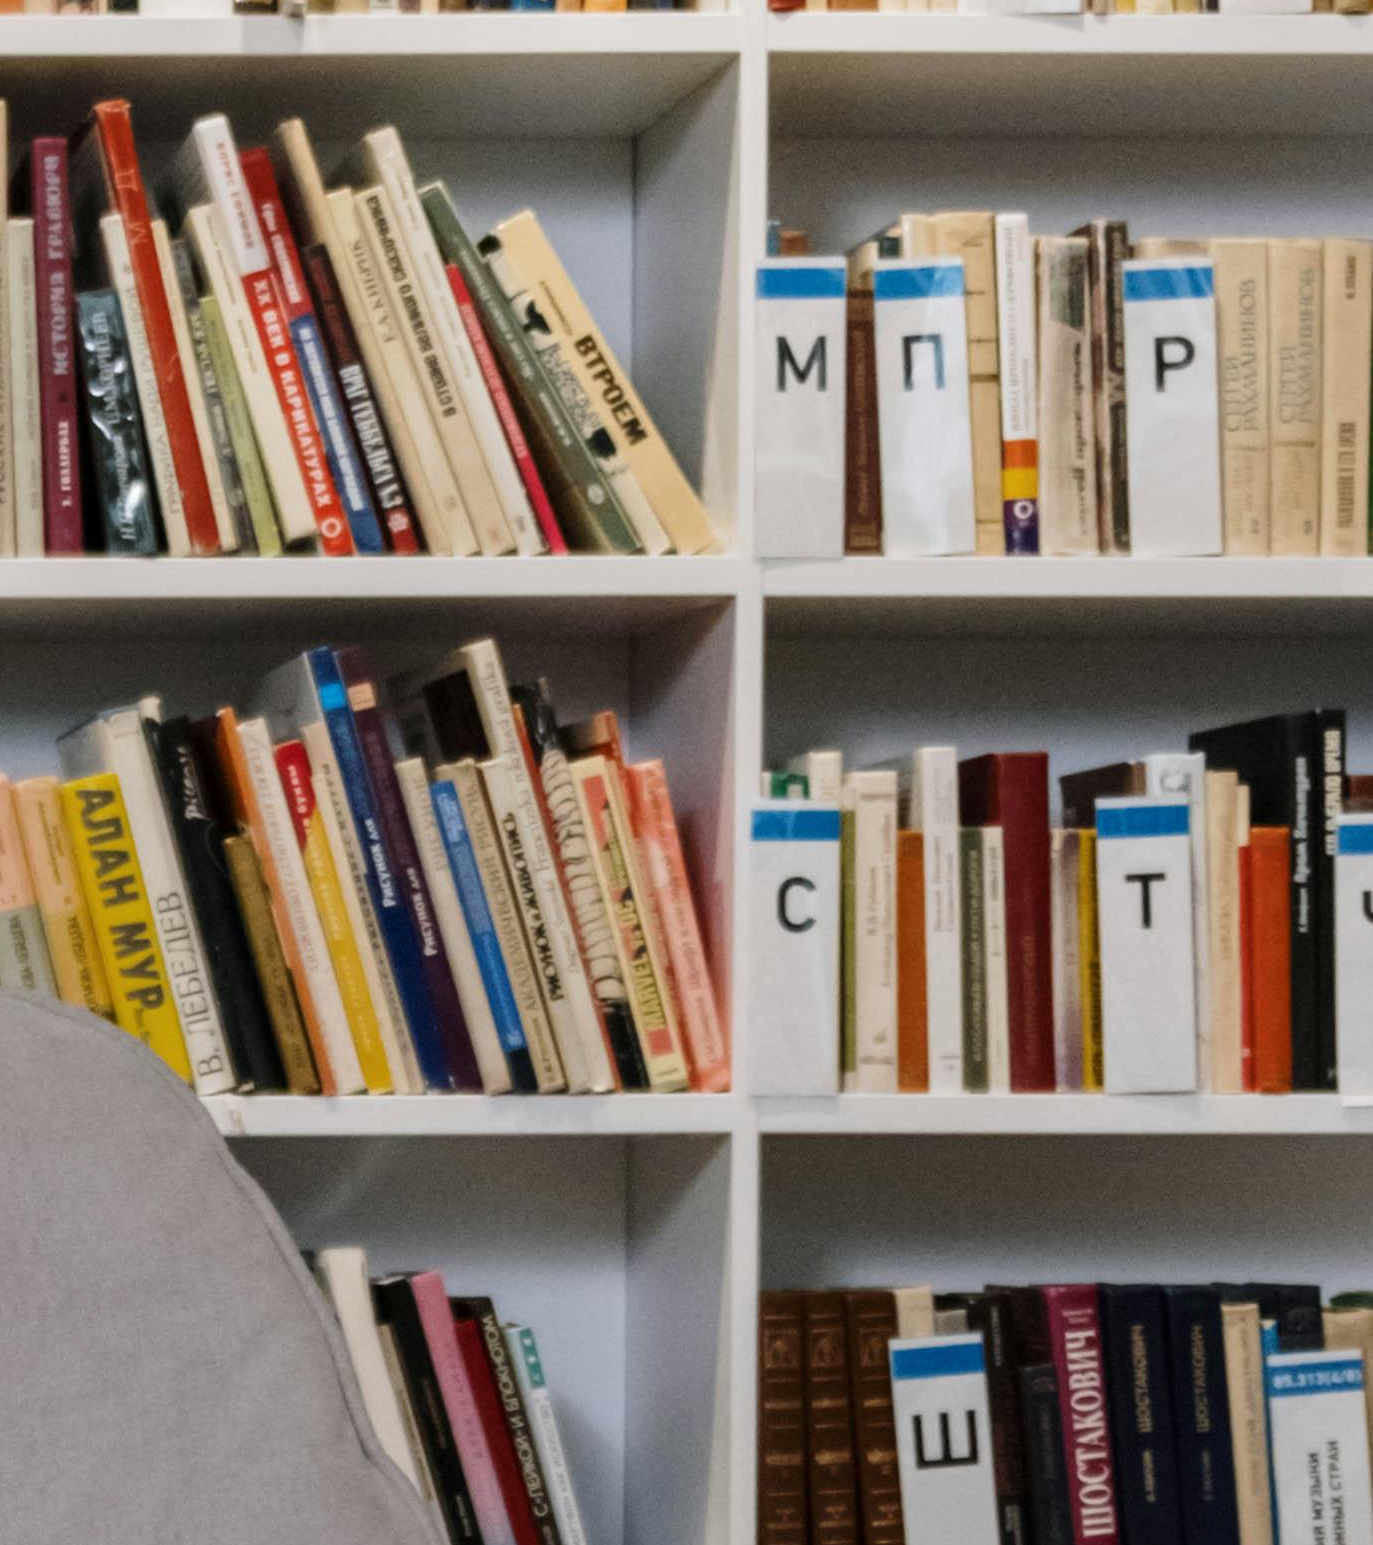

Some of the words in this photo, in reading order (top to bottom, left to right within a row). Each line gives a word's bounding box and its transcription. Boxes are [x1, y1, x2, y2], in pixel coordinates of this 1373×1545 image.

[46, 271, 70, 376] ИСТОРИЯ
[261, 309, 281, 348] ВЕК
[275, 352, 287, 365] В
[776, 334, 829, 392] М
[903, 333, 945, 391] П
[1155, 335, 1196, 393] Р
[571, 333, 649, 447] ВТРОЕМ
[280, 371, 328, 508] КАРИКАТУРАХ
[74, 787, 126, 903] АЛАН
[109, 920, 166, 1010] МУР
[777, 876, 817, 932] С
[1125, 871, 1166, 929] Т
[155, 891, 217, 1037] ЛЕБЕДЕВ
[194, 1046, 225, 1078] В.
[913, 1408, 979, 1469] Ш
[1067, 1327, 1114, 1537] ШОСТАКОВИЧ
[1307, 1452, 1320, 1527] МУЗЫКИ
[1326, 1440, 1341, 1490] СТРАН
